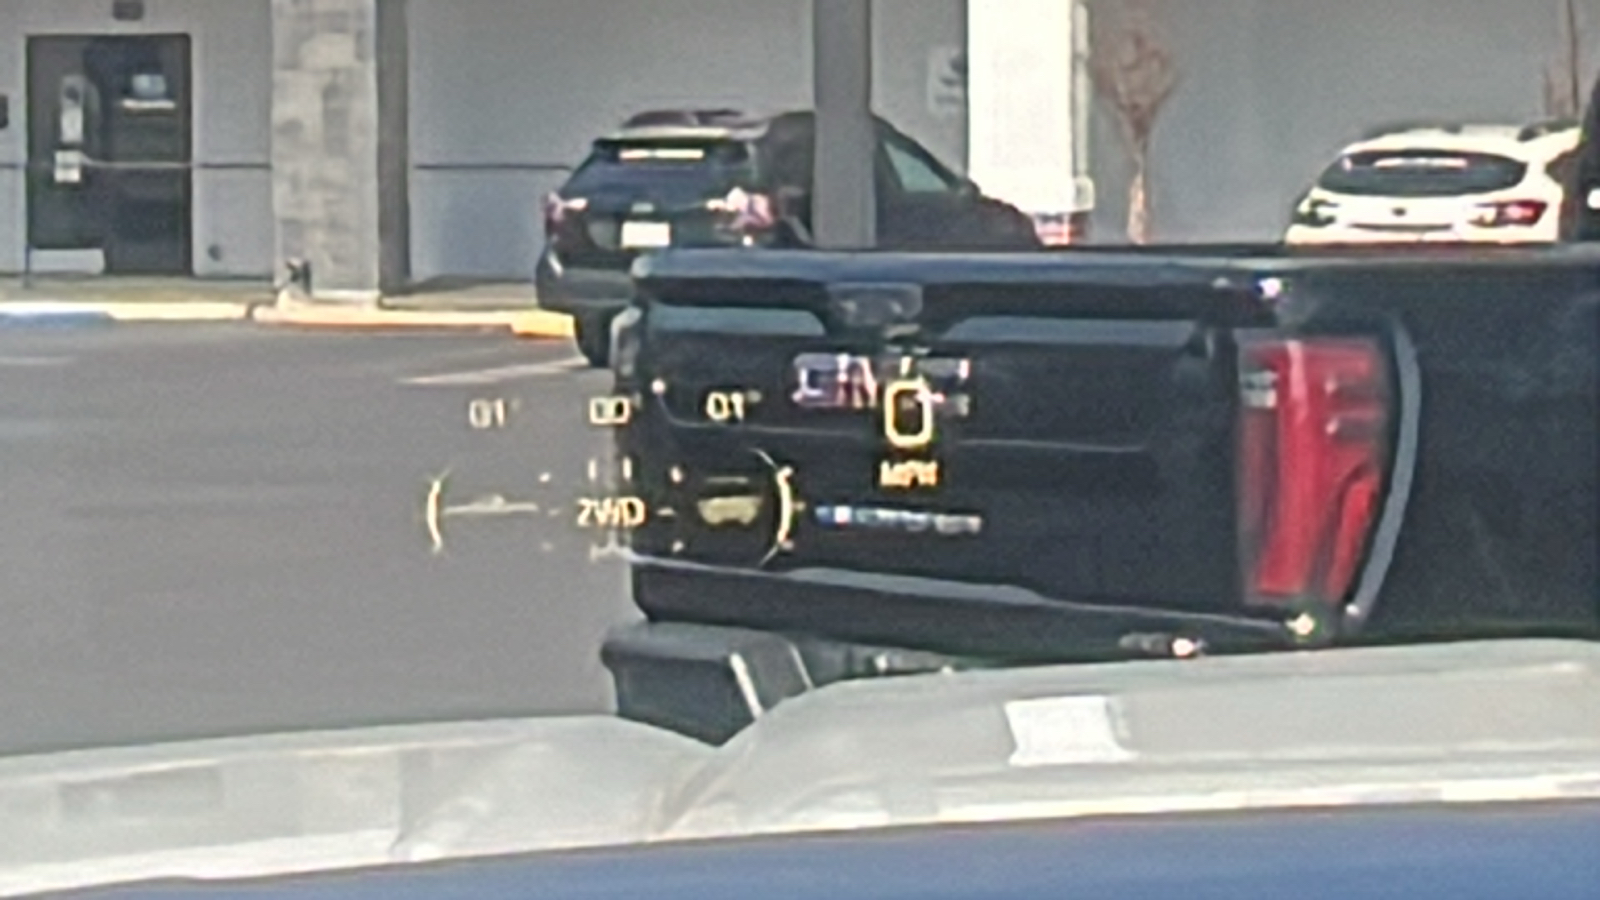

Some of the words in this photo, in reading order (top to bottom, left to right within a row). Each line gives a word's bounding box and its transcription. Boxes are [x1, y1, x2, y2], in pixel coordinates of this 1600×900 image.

[884, 380, 933, 446] 0
[880, 460, 938, 486] MPH
[577, 496, 645, 527] 2WD
